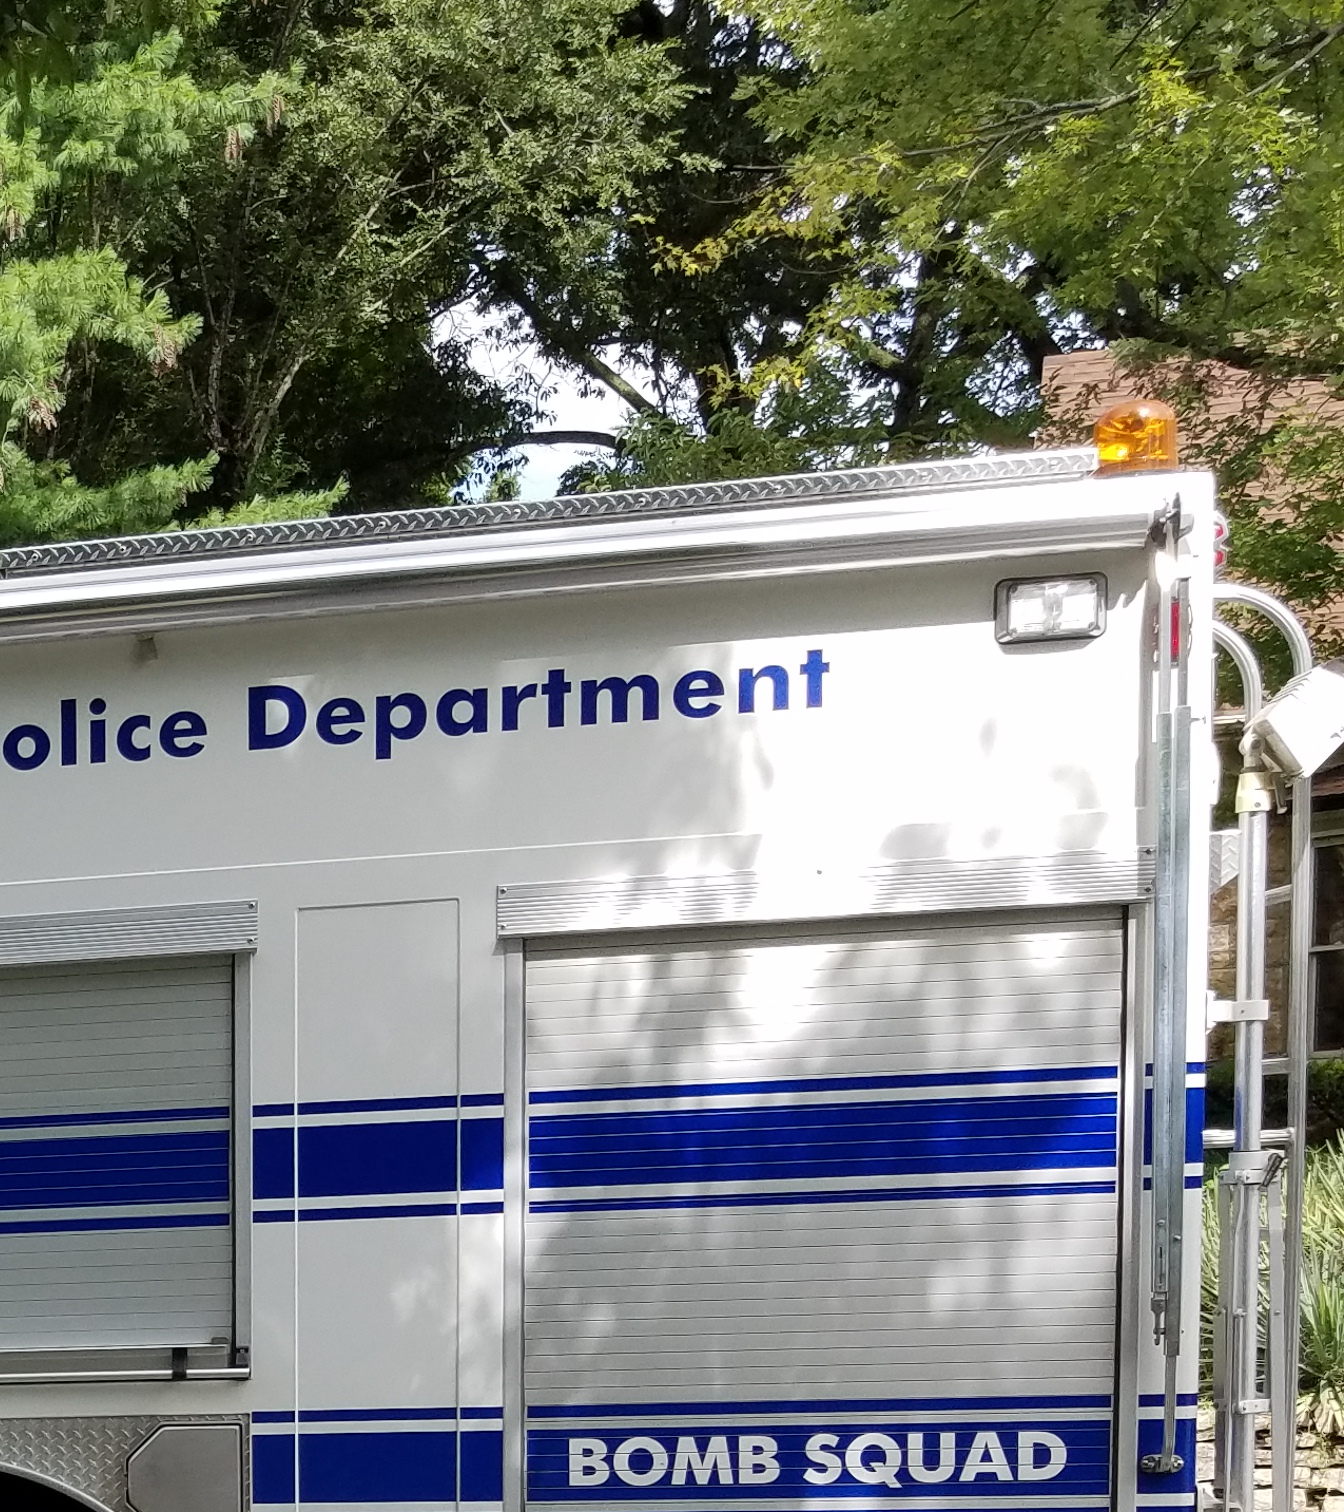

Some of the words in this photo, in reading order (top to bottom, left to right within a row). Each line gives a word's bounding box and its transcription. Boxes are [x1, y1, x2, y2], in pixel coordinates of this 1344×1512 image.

[247, 649, 830, 760] Department
[567, 1434, 780, 1487] BOMB
[803, 1431, 1068, 1488] SQUAD
